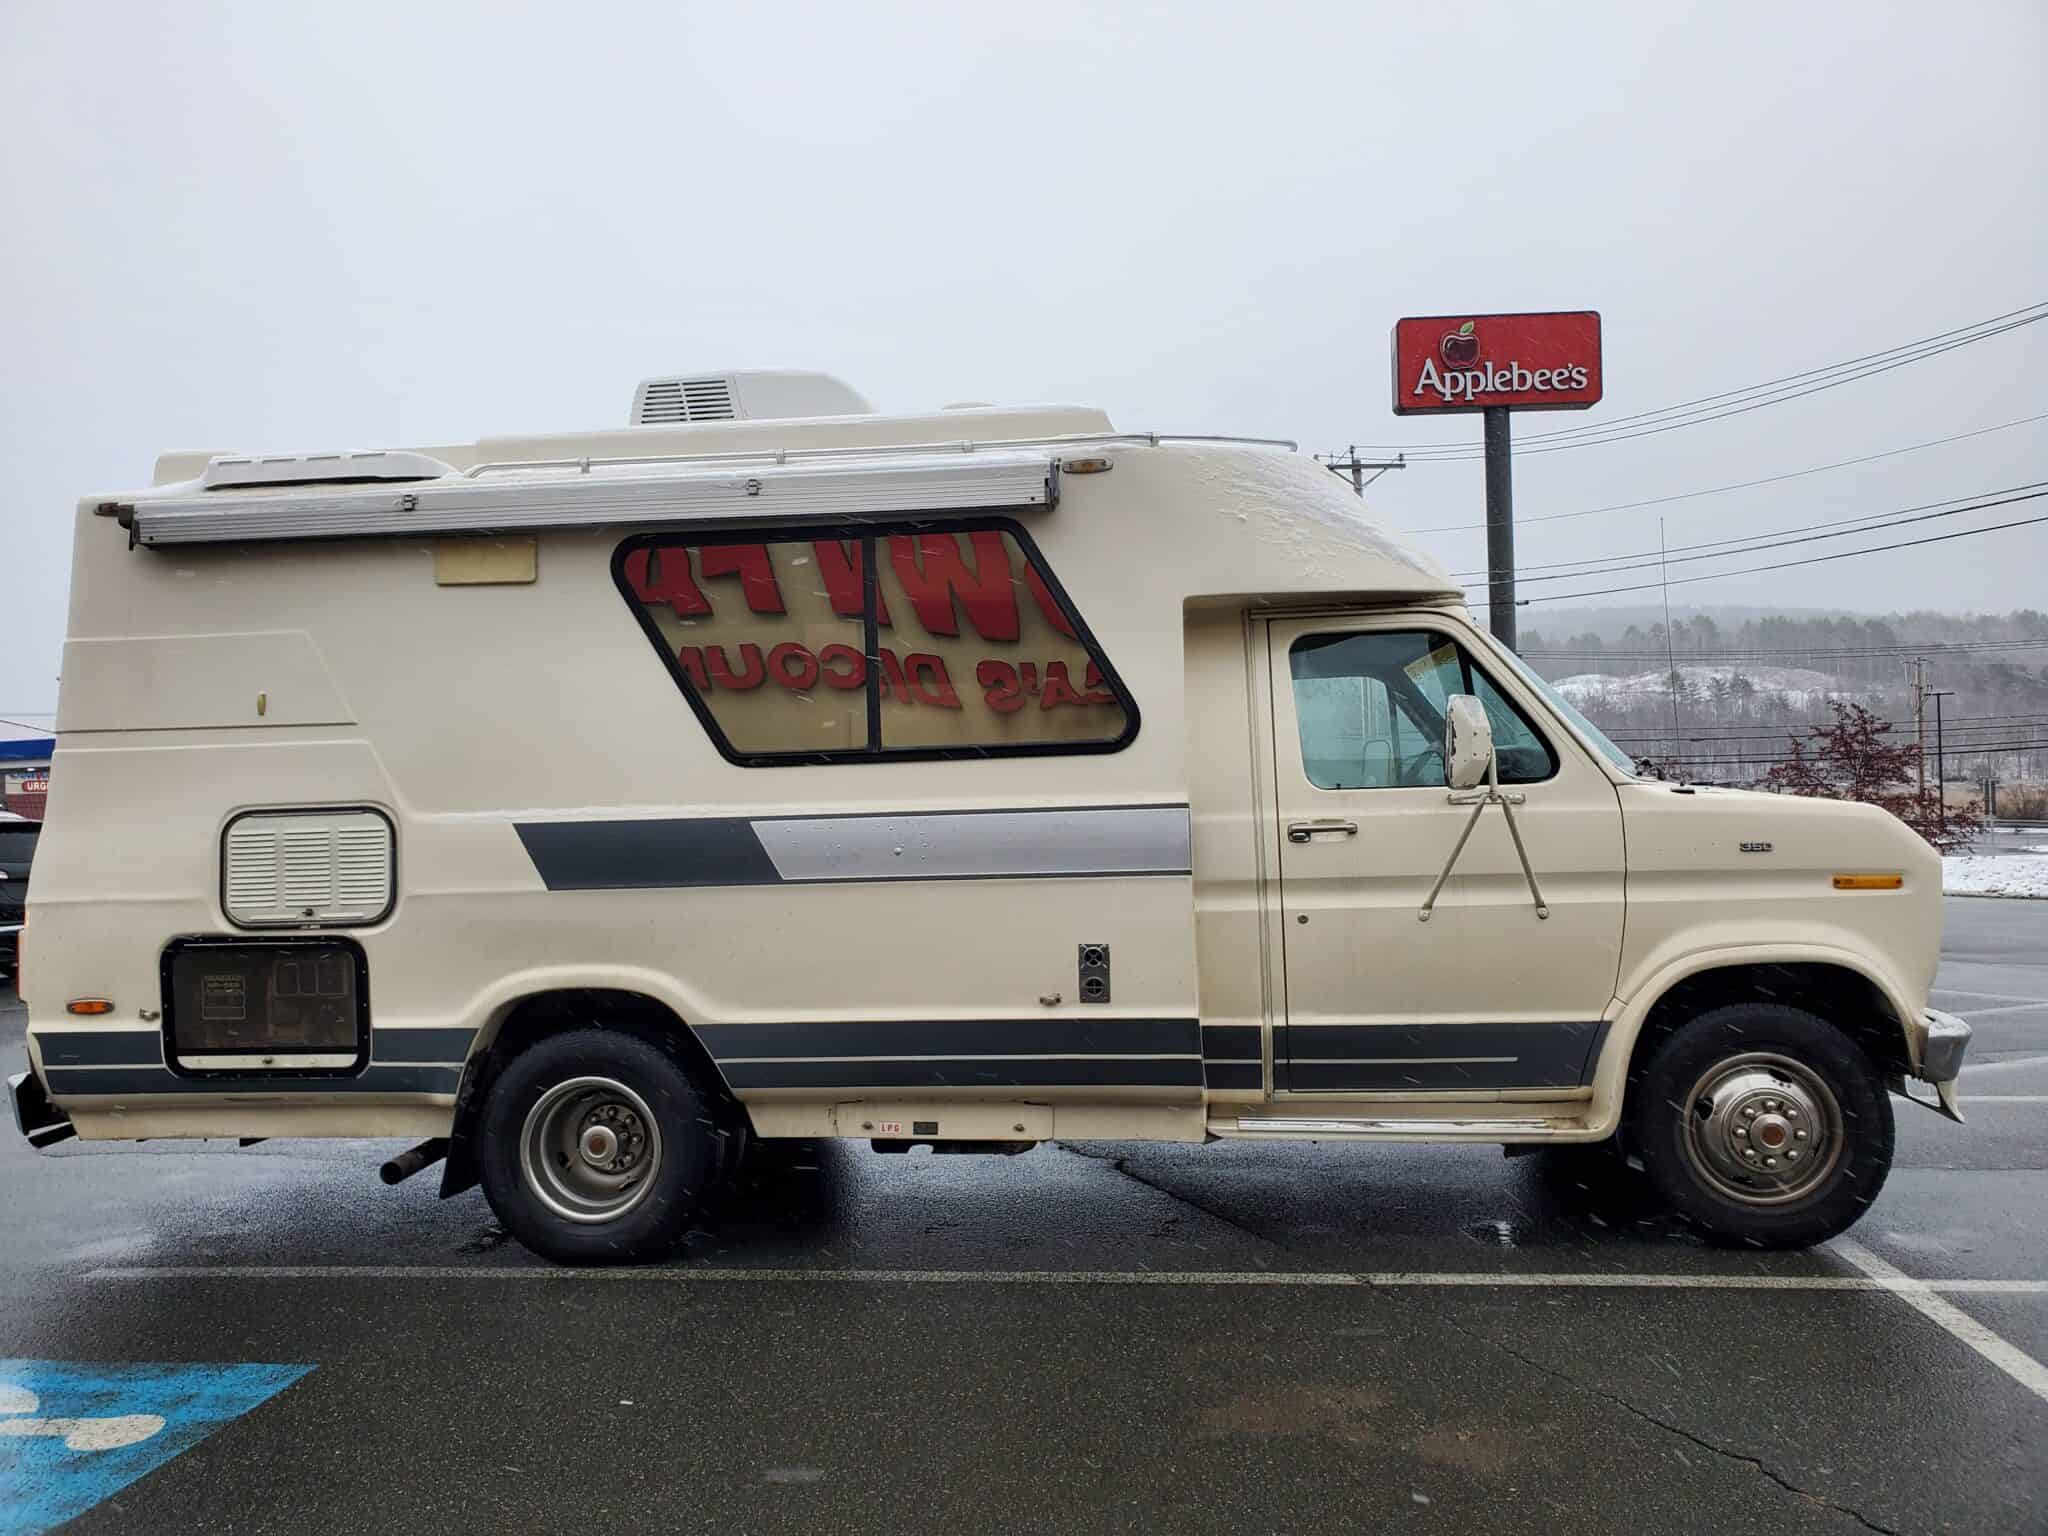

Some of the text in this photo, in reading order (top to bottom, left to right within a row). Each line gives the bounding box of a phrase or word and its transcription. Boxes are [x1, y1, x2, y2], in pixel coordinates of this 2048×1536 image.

[1414, 357, 1588, 401] Applebee's
[27, 781, 48, 791] URG
[1739, 842, 1773, 853] 350
[881, 1123, 900, 1132] LPG
